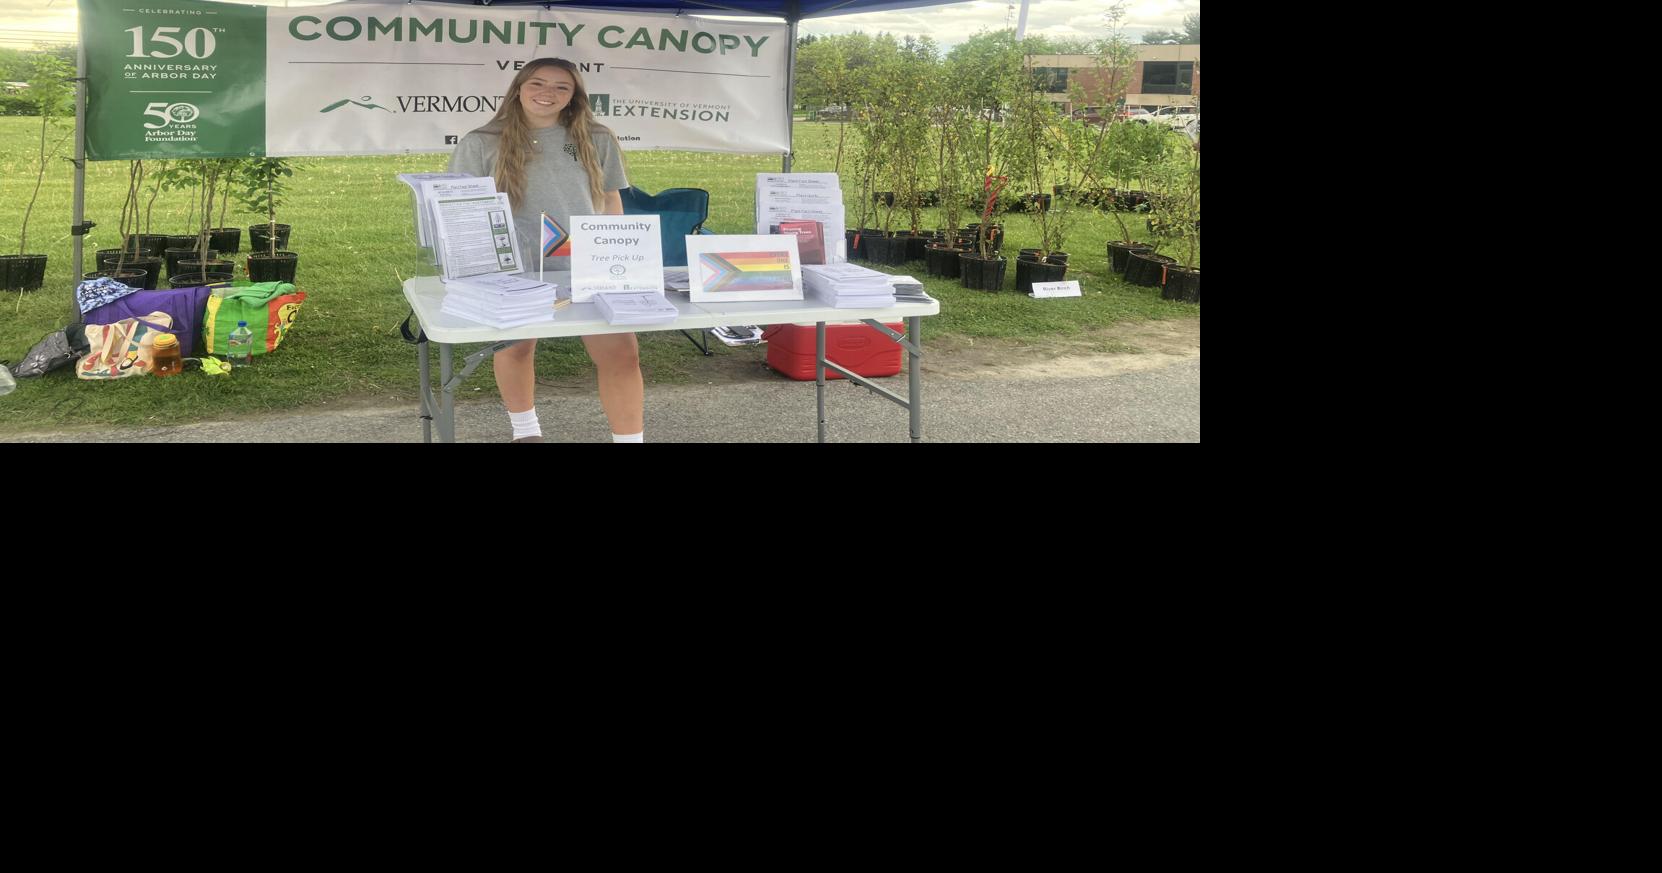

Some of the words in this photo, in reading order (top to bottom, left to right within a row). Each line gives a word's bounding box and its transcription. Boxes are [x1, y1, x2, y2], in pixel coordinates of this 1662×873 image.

[288, 15, 585, 46] COMMUNITY
[597, 25, 770, 57] CANOPY
[496, 60, 605, 73] VENT
[629, 99, 676, 107] UNIVERSITY
[143, 102, 200, 129] 50
[613, 105, 730, 122] EXTENSION
[580, 222, 651, 232] Community
[593, 236, 640, 247] Canopy
